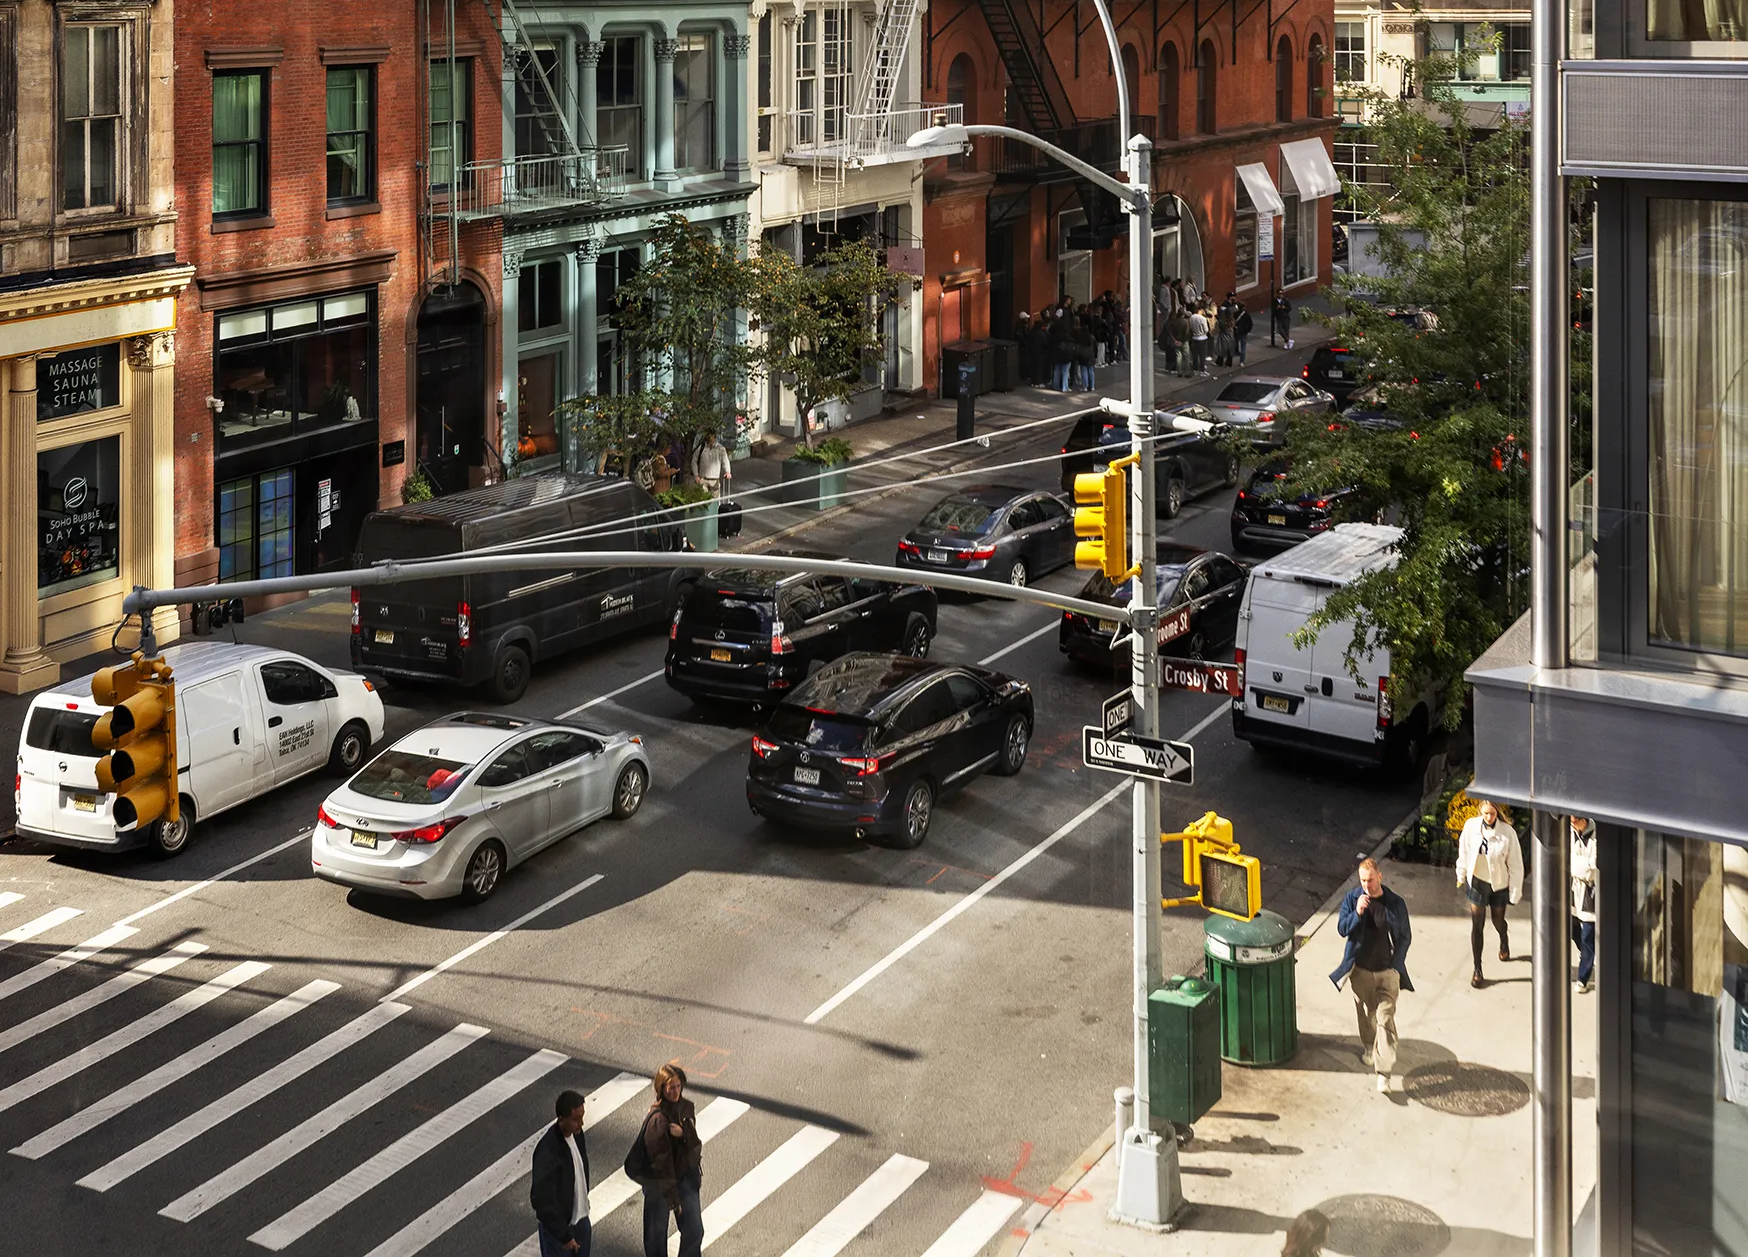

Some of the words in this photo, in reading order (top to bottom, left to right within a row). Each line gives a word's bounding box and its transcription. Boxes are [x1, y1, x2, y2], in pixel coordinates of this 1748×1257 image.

[49, 356, 103, 377] MASSAGE
[53, 373, 99, 392] SAUNA
[54, 388, 98, 408] STEAM
[45, 528, 73, 544] DAY
[80, 520, 105, 535] SPA
[1157, 620, 1178, 644] roome
[1179, 611, 1188, 632] St
[1164, 664, 1209, 693] Crosby
[1214, 669, 1229, 691] St
[1108, 705, 1126, 727] ONE
[1094, 742, 1126, 760] ONE
[1143, 748, 1178, 769] WAY
